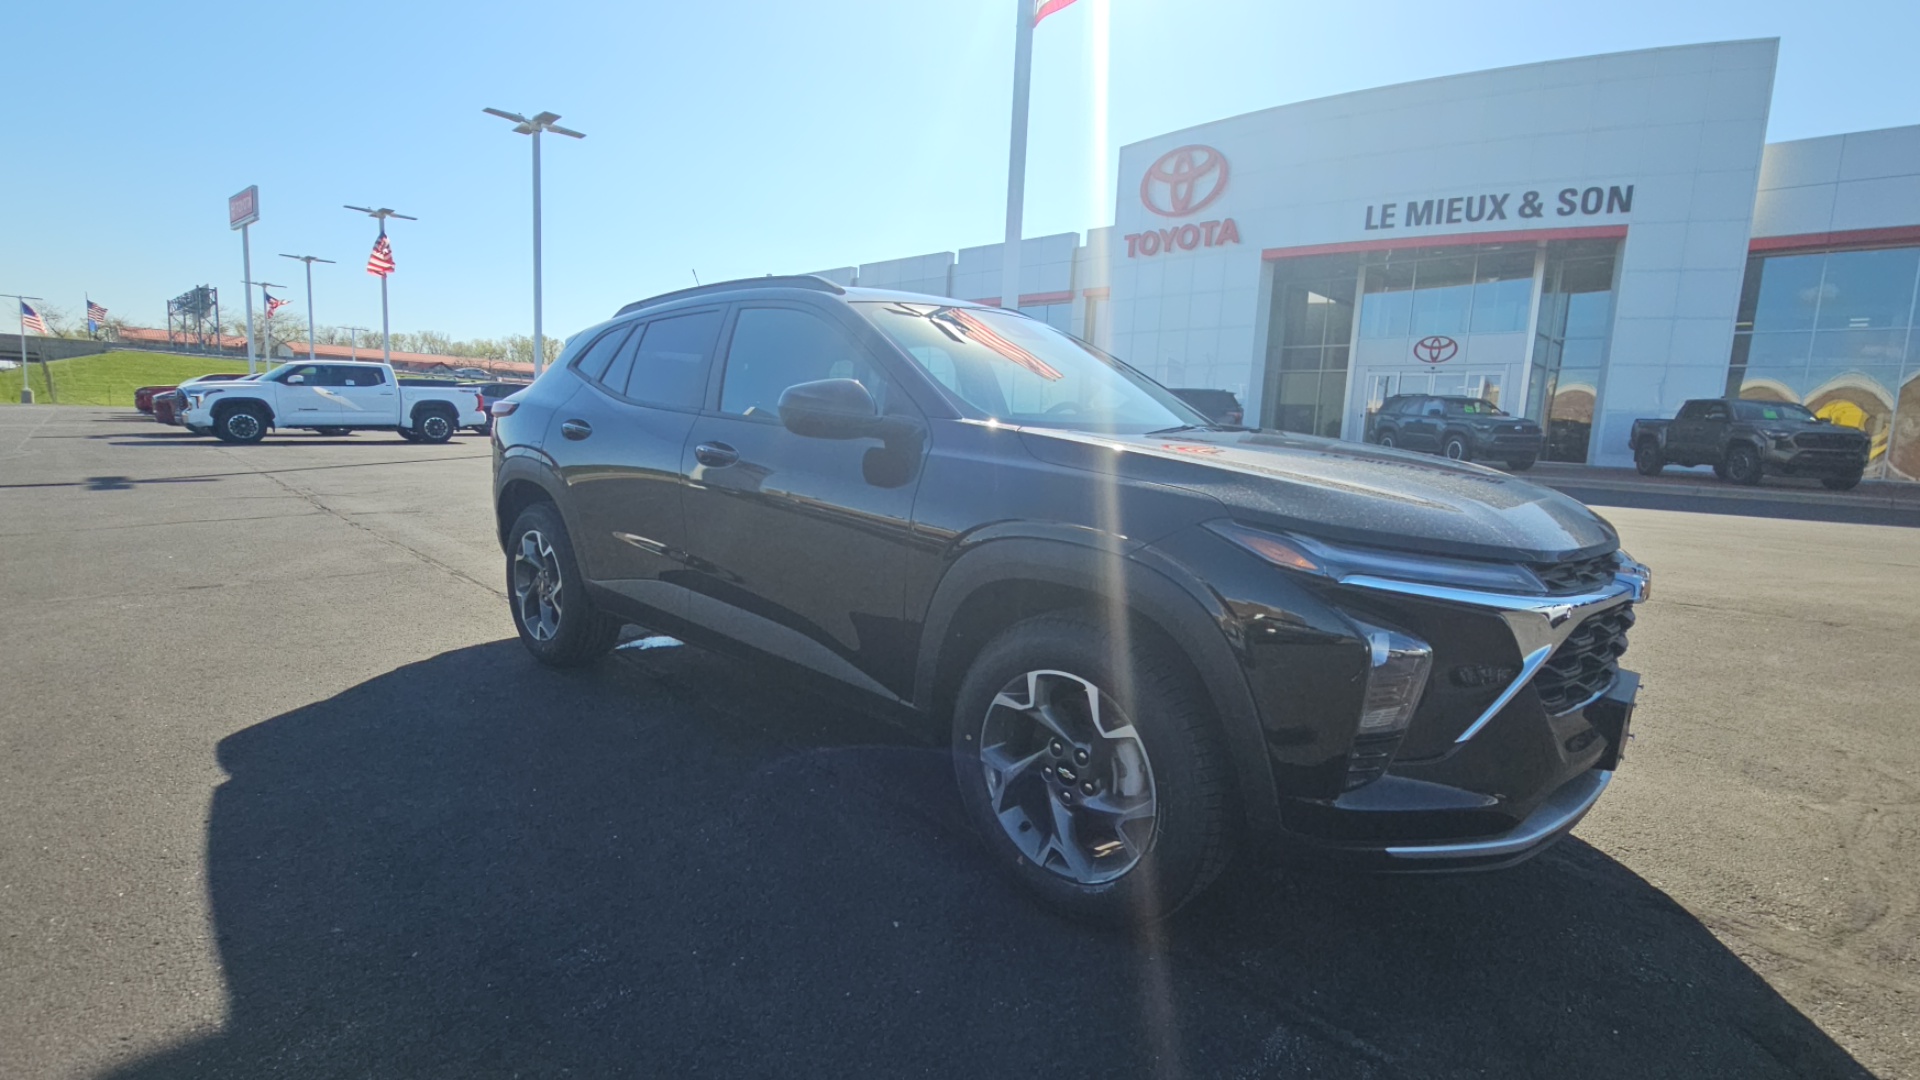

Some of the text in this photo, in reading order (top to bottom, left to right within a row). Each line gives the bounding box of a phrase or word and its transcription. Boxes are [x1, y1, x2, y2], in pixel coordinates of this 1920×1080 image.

[1364, 185, 1635, 230] LE MIEUX & SON
[1124, 218, 1241, 258] TOYOTA
